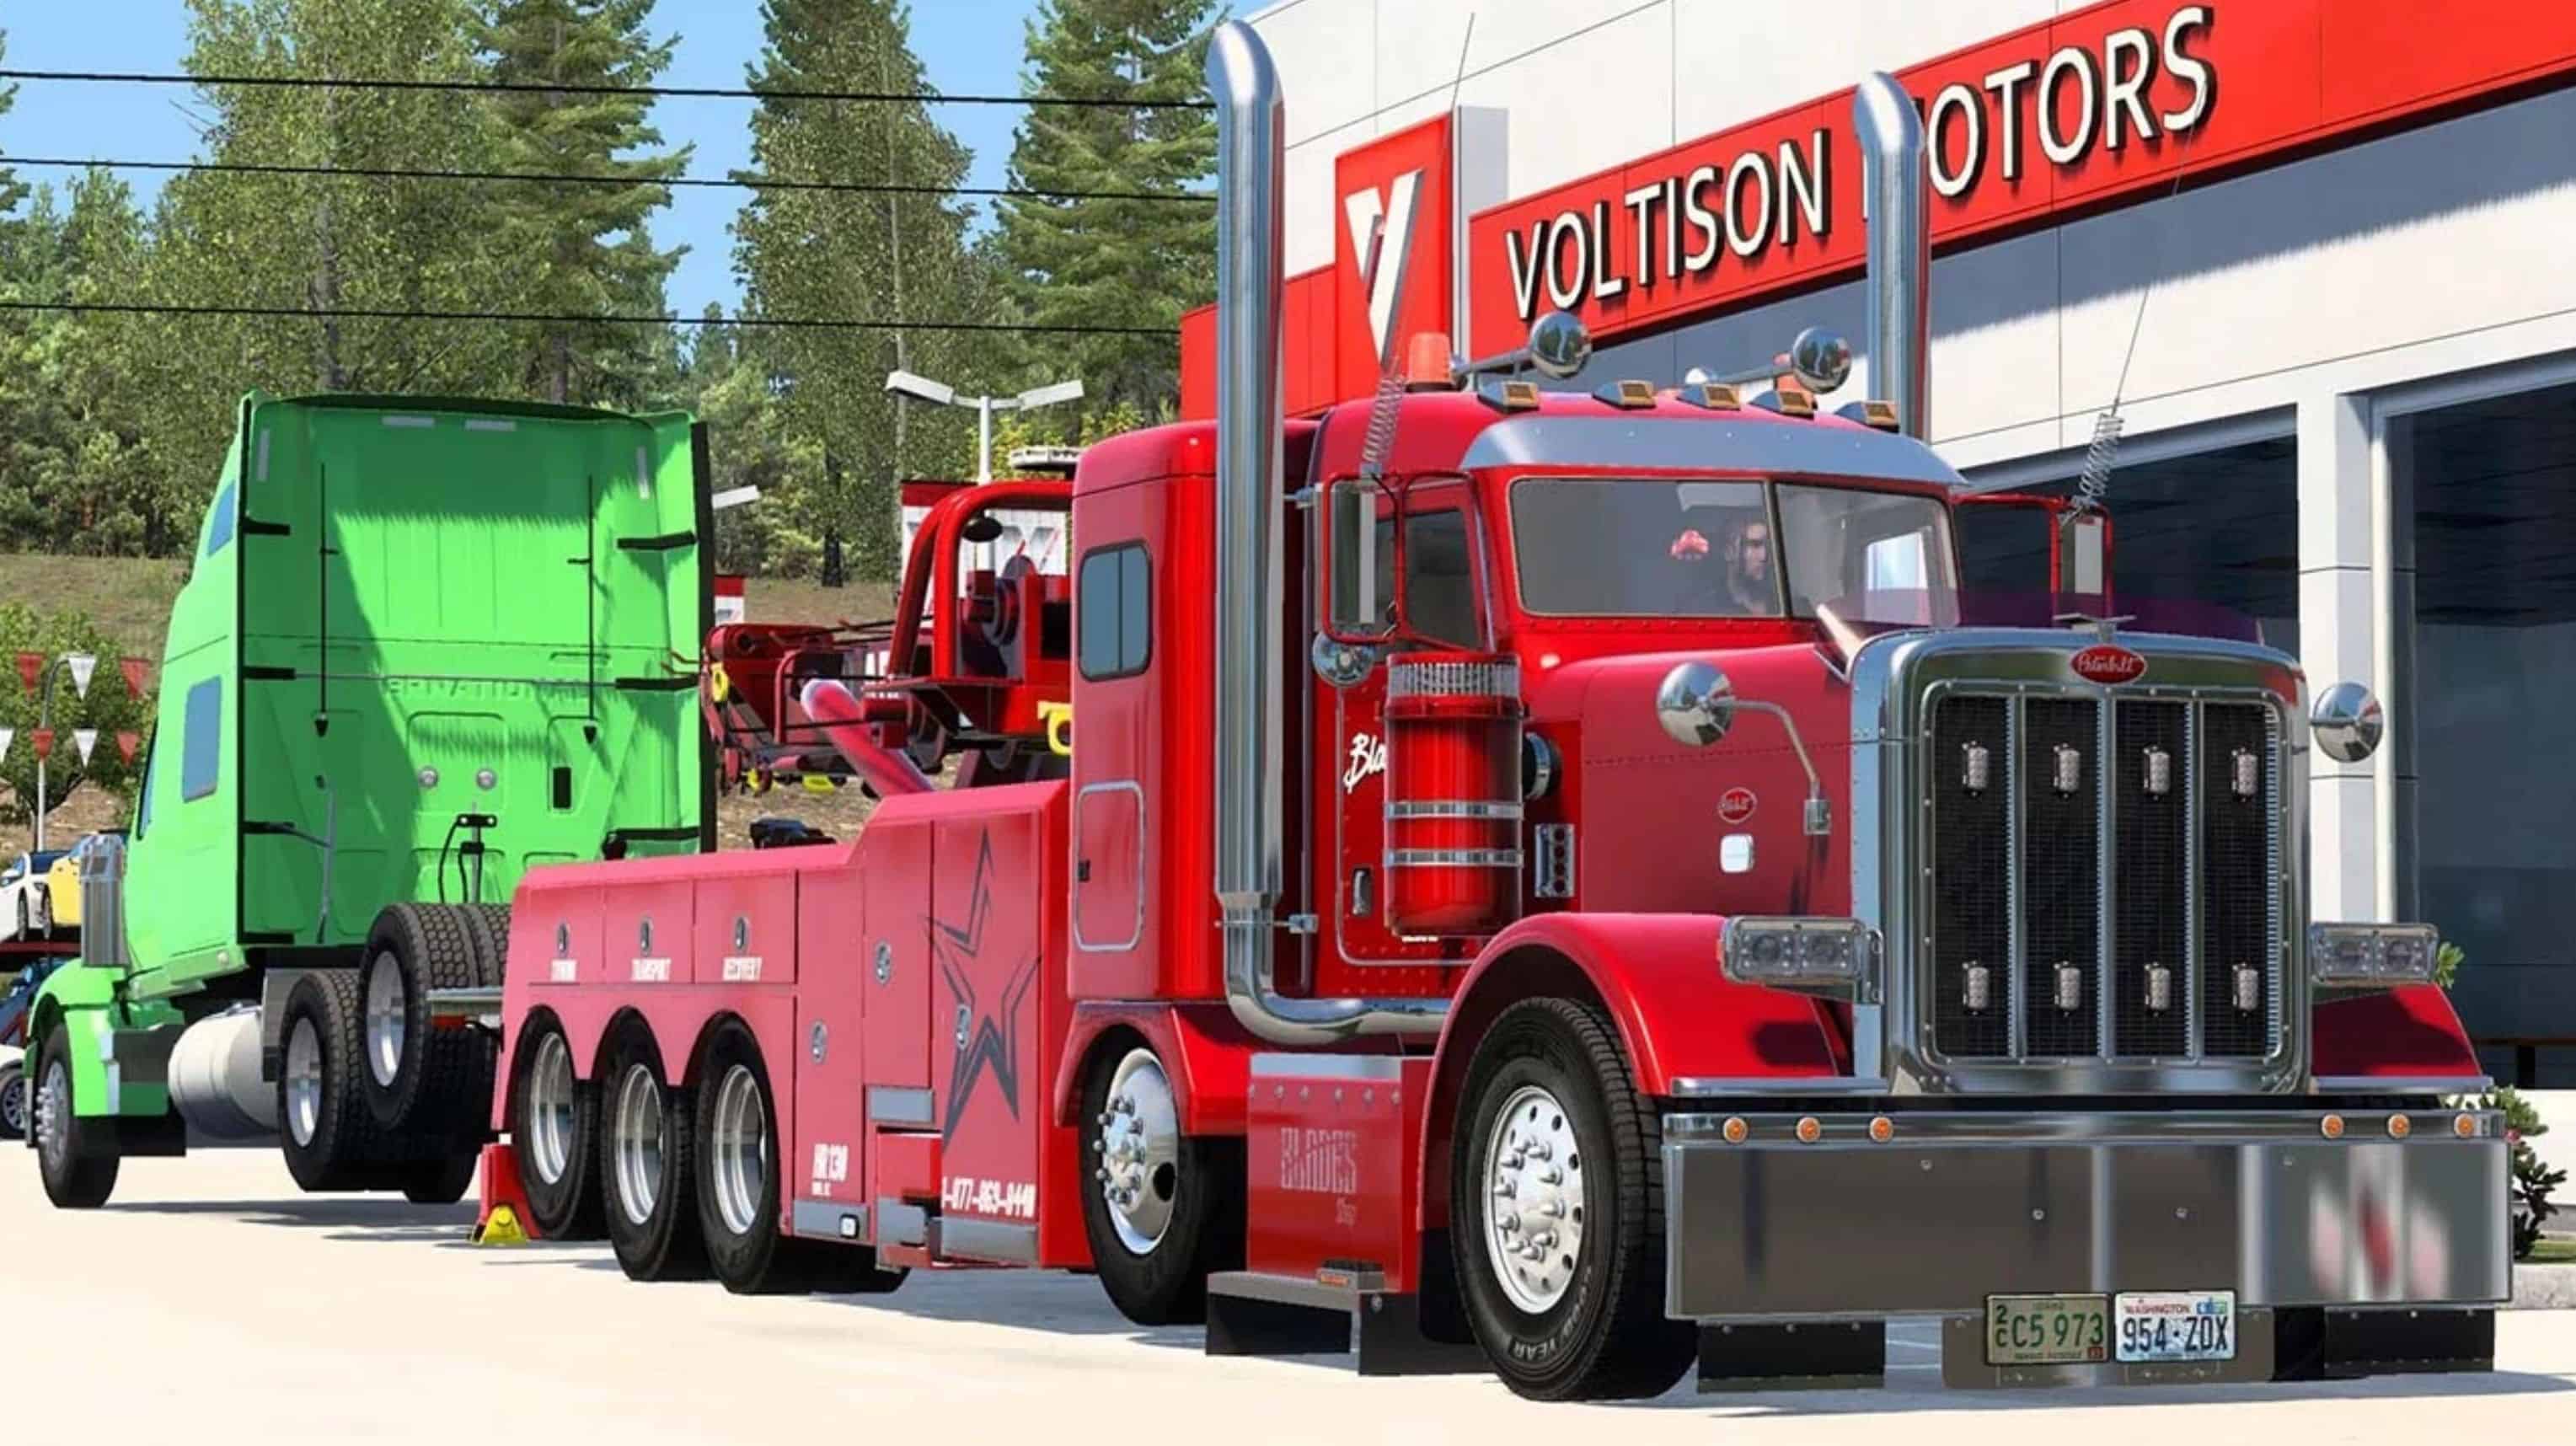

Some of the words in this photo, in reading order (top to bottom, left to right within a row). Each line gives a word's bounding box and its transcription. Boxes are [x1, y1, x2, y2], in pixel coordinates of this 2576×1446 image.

[1506, 127, 1830, 320] VOLTISON
[1862, 6, 2215, 222] OTORS
[1280, 1127, 1357, 1194] BLADES
